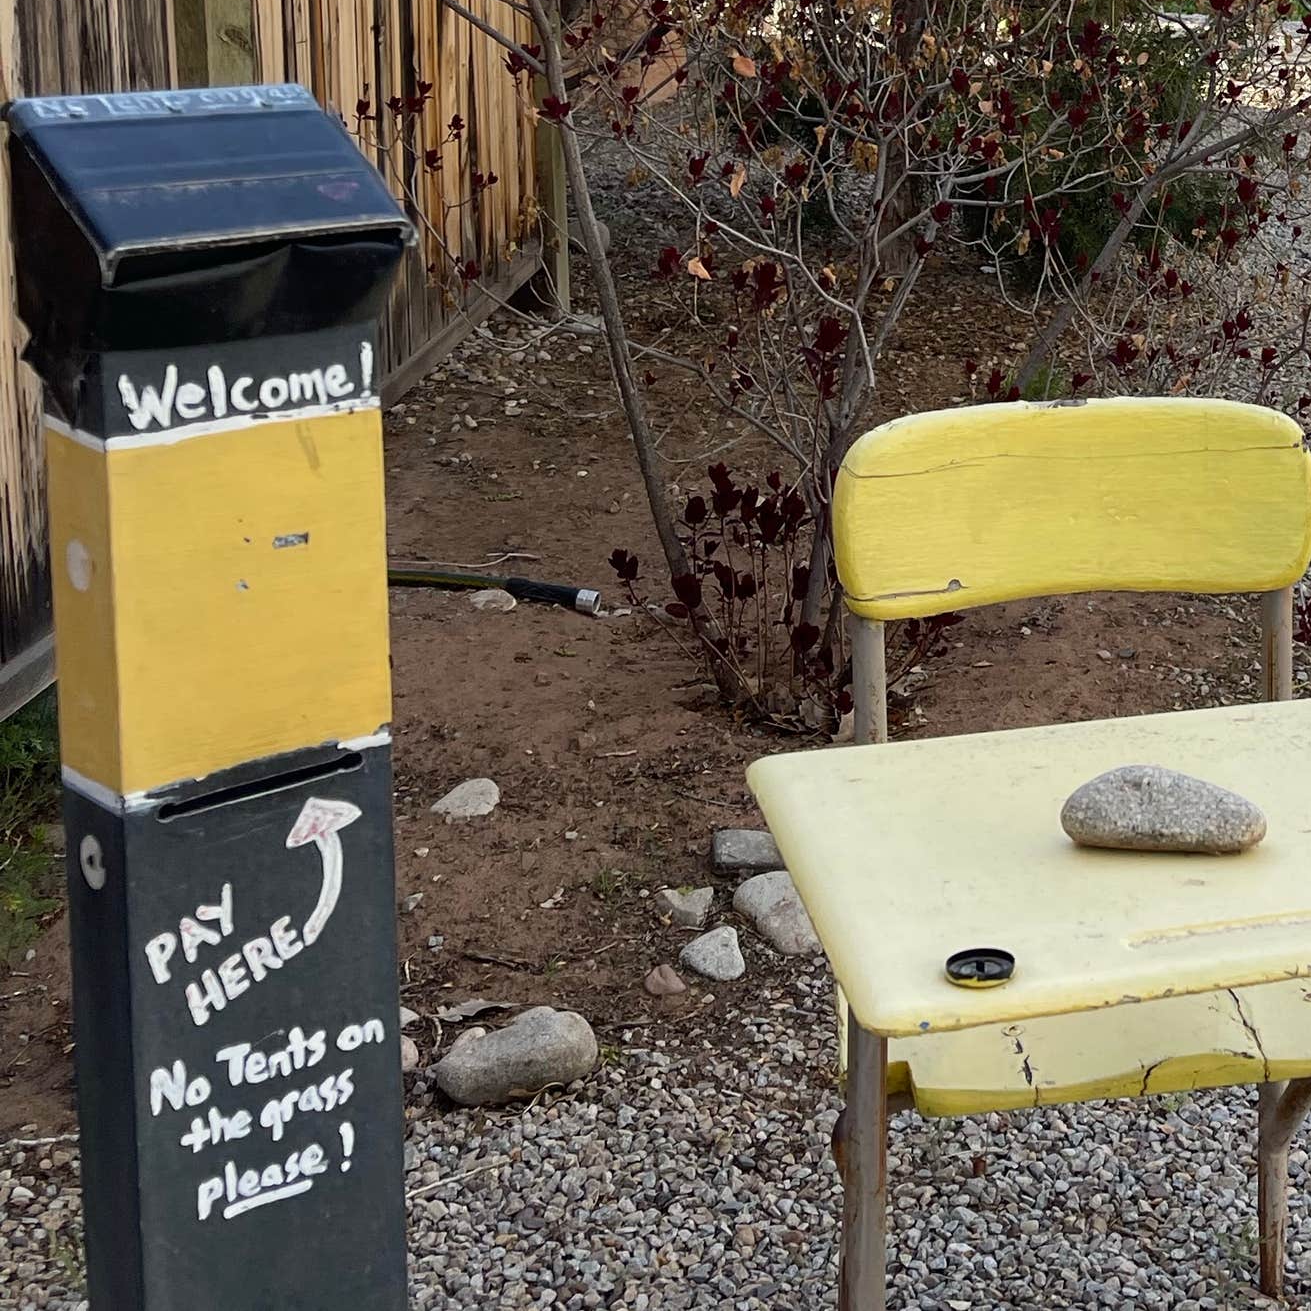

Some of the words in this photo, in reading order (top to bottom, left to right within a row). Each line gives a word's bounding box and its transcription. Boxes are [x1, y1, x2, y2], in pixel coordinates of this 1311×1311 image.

[118, 341, 374, 430] Welcome!
[144, 881, 234, 985] PAY
[185, 915, 304, 1026] HERE
[150, 1059, 212, 1117] No
[216, 1026, 327, 1086] Tents
[336, 1018, 385, 1052] on
[180, 1106, 253, 1154] the
[259, 1068, 354, 1142] grass
